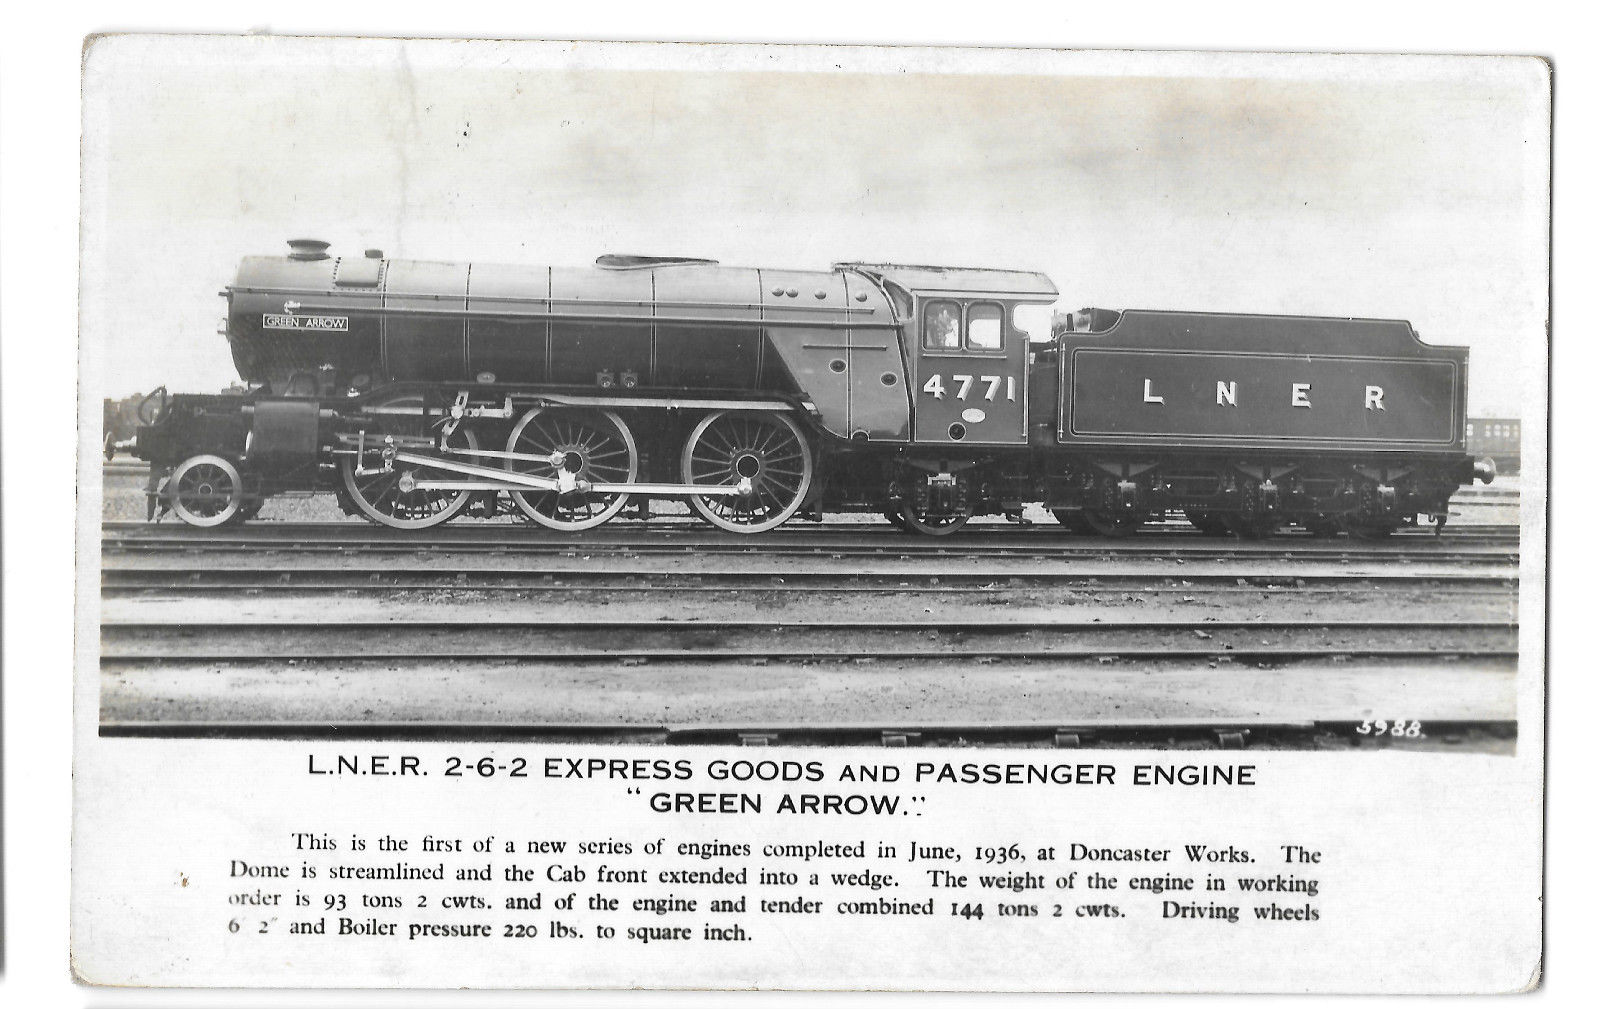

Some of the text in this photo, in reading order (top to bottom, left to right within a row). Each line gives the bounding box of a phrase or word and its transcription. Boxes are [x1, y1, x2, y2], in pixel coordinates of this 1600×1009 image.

[267, 316, 344, 329] GREEN ARROW
[923, 374, 1016, 402] 4771
[308, 754, 1257, 786] L.N.E.R. 2-6-2 EXPRESS GOODS AND PASSENGER ENGINE
[291, 832, 1322, 865] This is the first of a new series of engines completed in June, 1936, at Doncaster Works. The
[230, 859, 1319, 897] Dome is streamlined and the Cab front extended into a wedge. The weight of the engine in working
[228, 888, 1320, 924] order is 93 tons 2 cwts. and of the engine and tender combined 144 tons 2 cwts. Driving wheels
[289, 917, 326, 935] and
[338, 917, 398, 936] Boiler
[408, 923, 492, 941] pressure
[503, 923, 538, 939] 220
[549, 920, 584, 939] lbs.
[596, 924, 616, 939] to
[627, 926, 692, 945] square
[703, 922, 752, 942] inch.
